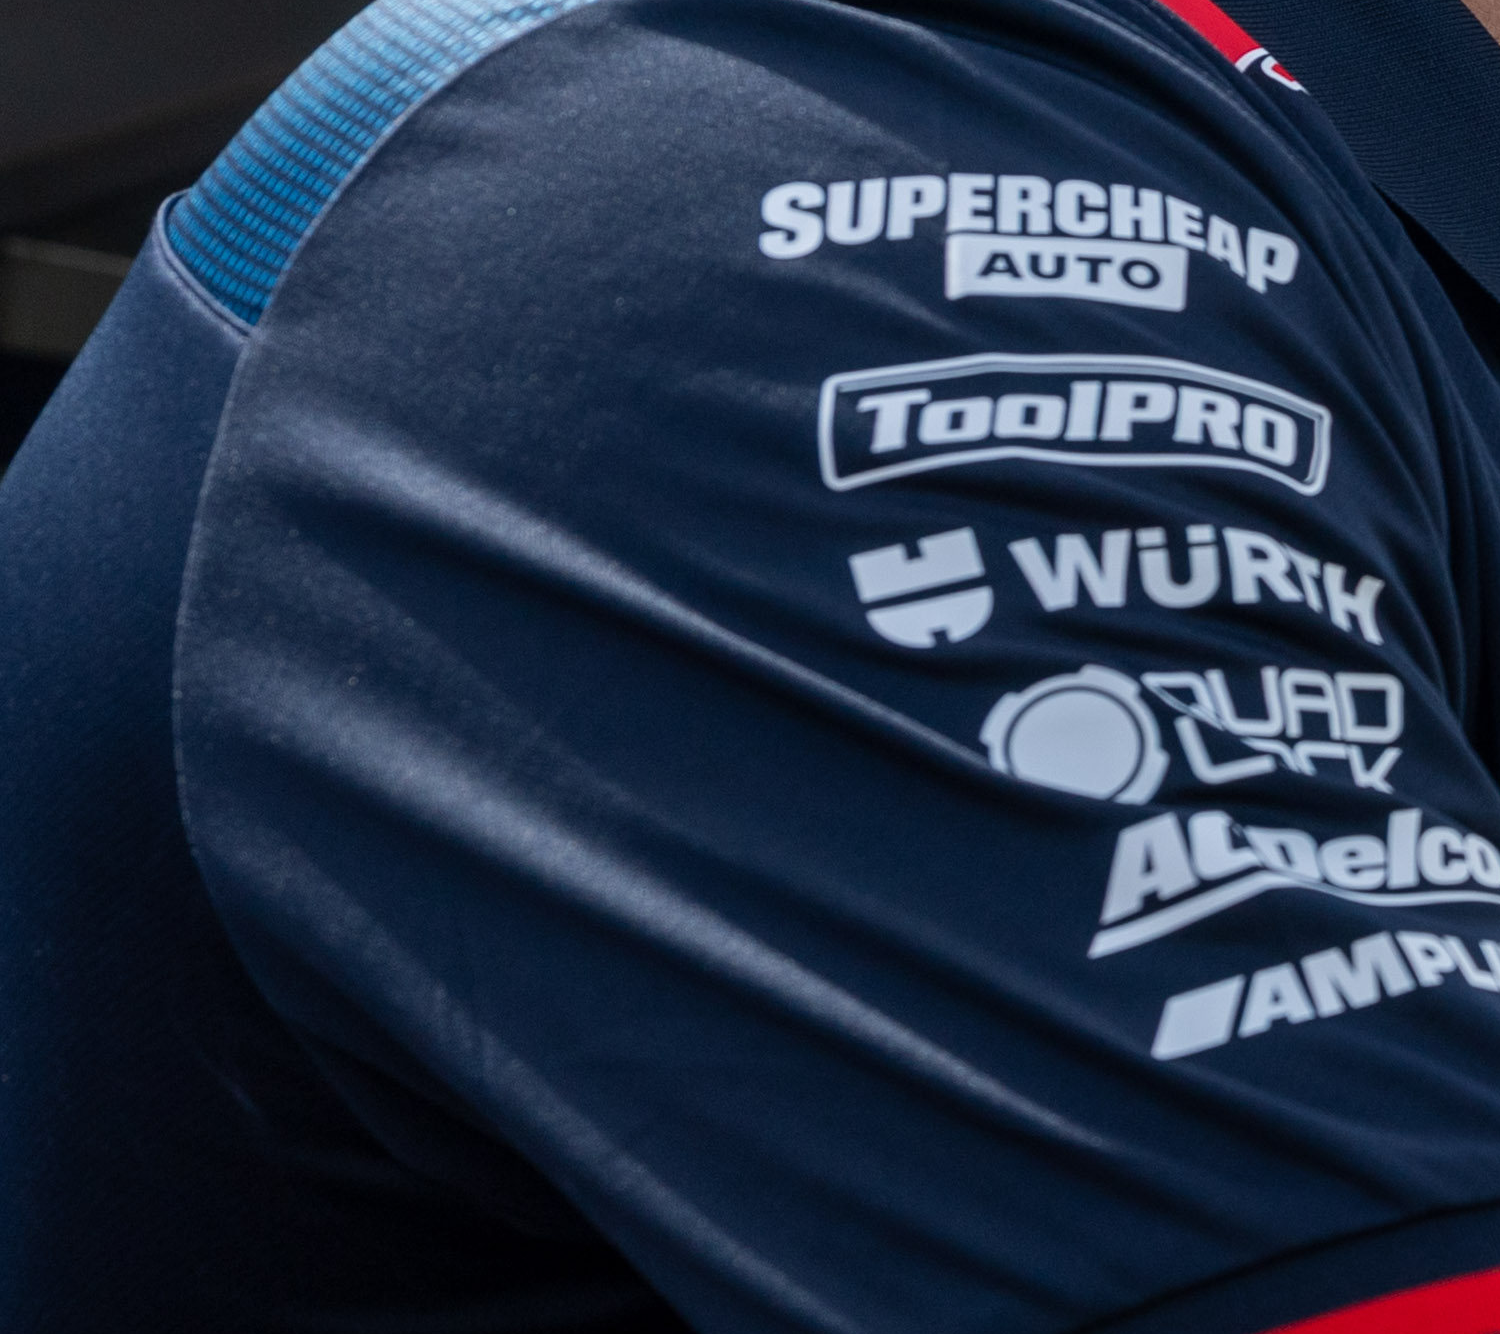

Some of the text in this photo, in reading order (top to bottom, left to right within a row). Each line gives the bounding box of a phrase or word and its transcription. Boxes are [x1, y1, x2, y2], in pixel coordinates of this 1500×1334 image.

[759, 172, 1300, 294] SUPERCHEAP
[977, 251, 1163, 291] AUTO
[1007, 524, 1386, 646] WÜRTH
